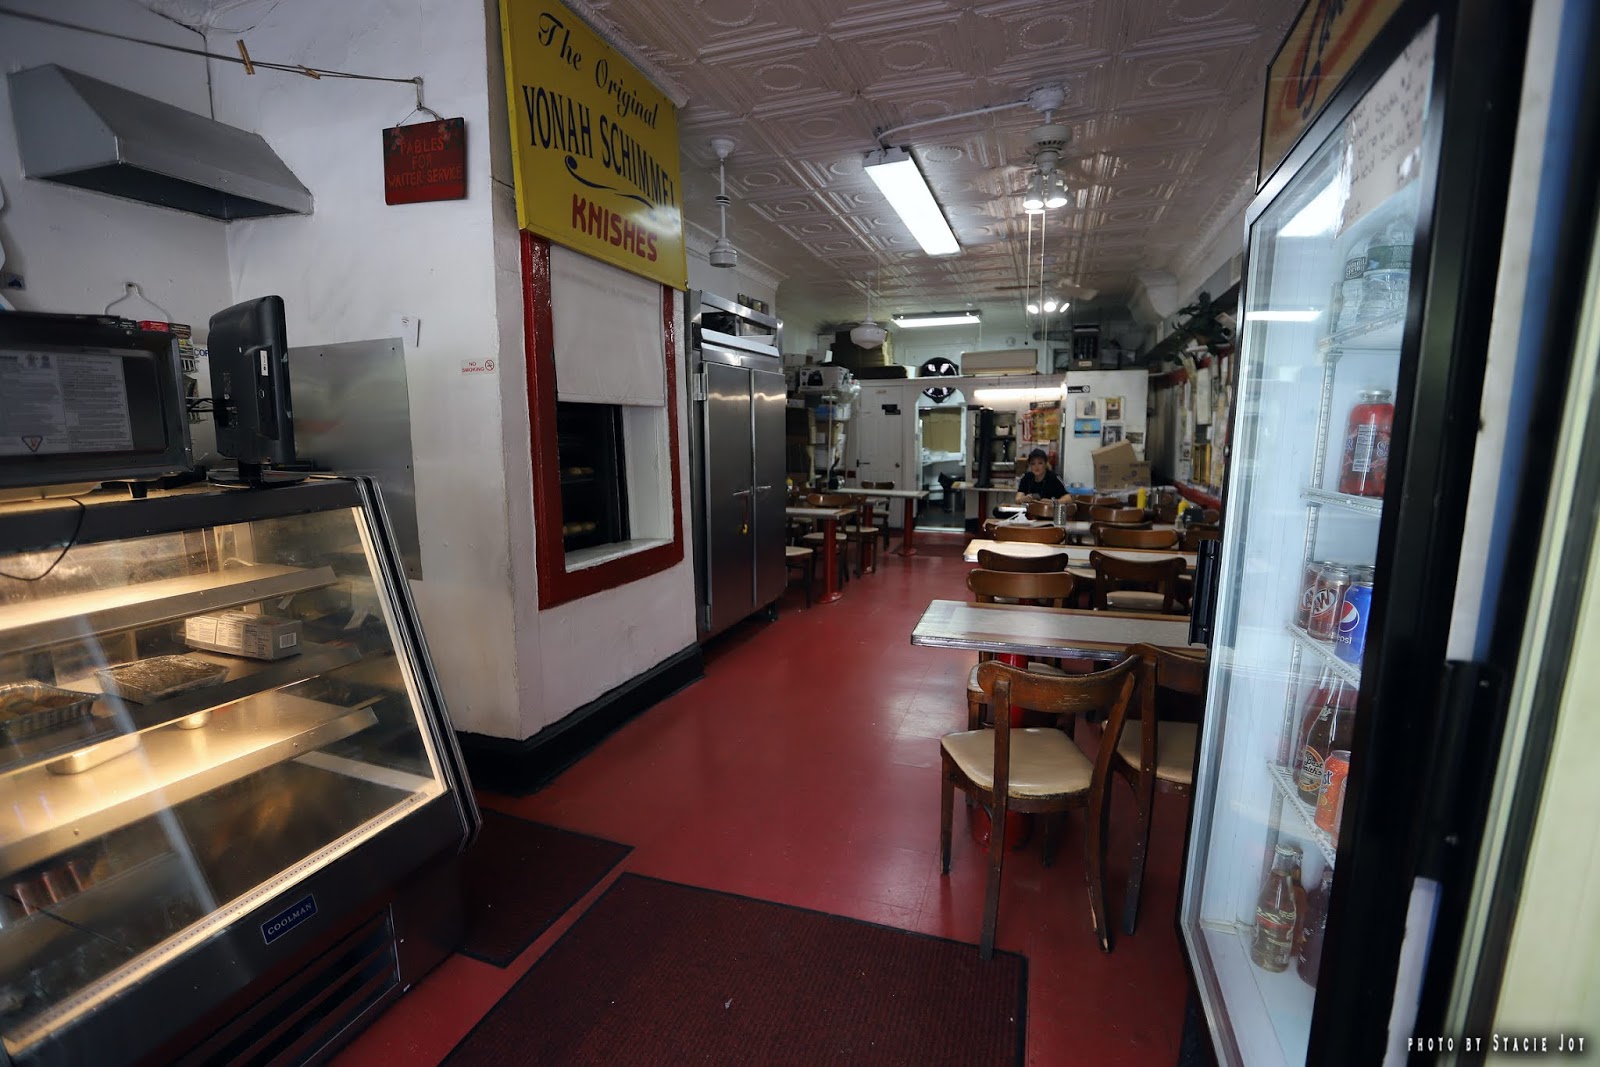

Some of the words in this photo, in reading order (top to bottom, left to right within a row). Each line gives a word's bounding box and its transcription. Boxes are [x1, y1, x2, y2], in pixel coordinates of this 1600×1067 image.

[538, 12, 583, 72] The
[595, 58, 659, 130] Original
[522, 85, 593, 160] YONAH
[400, 136, 444, 154] TABLES
[412, 154, 432, 169] FOR
[387, 170, 422, 188] WAITER
[427, 165, 463, 183] SERVICE
[572, 193, 658, 263] KNISHES
[267, 902, 312, 935] COOLMAN
